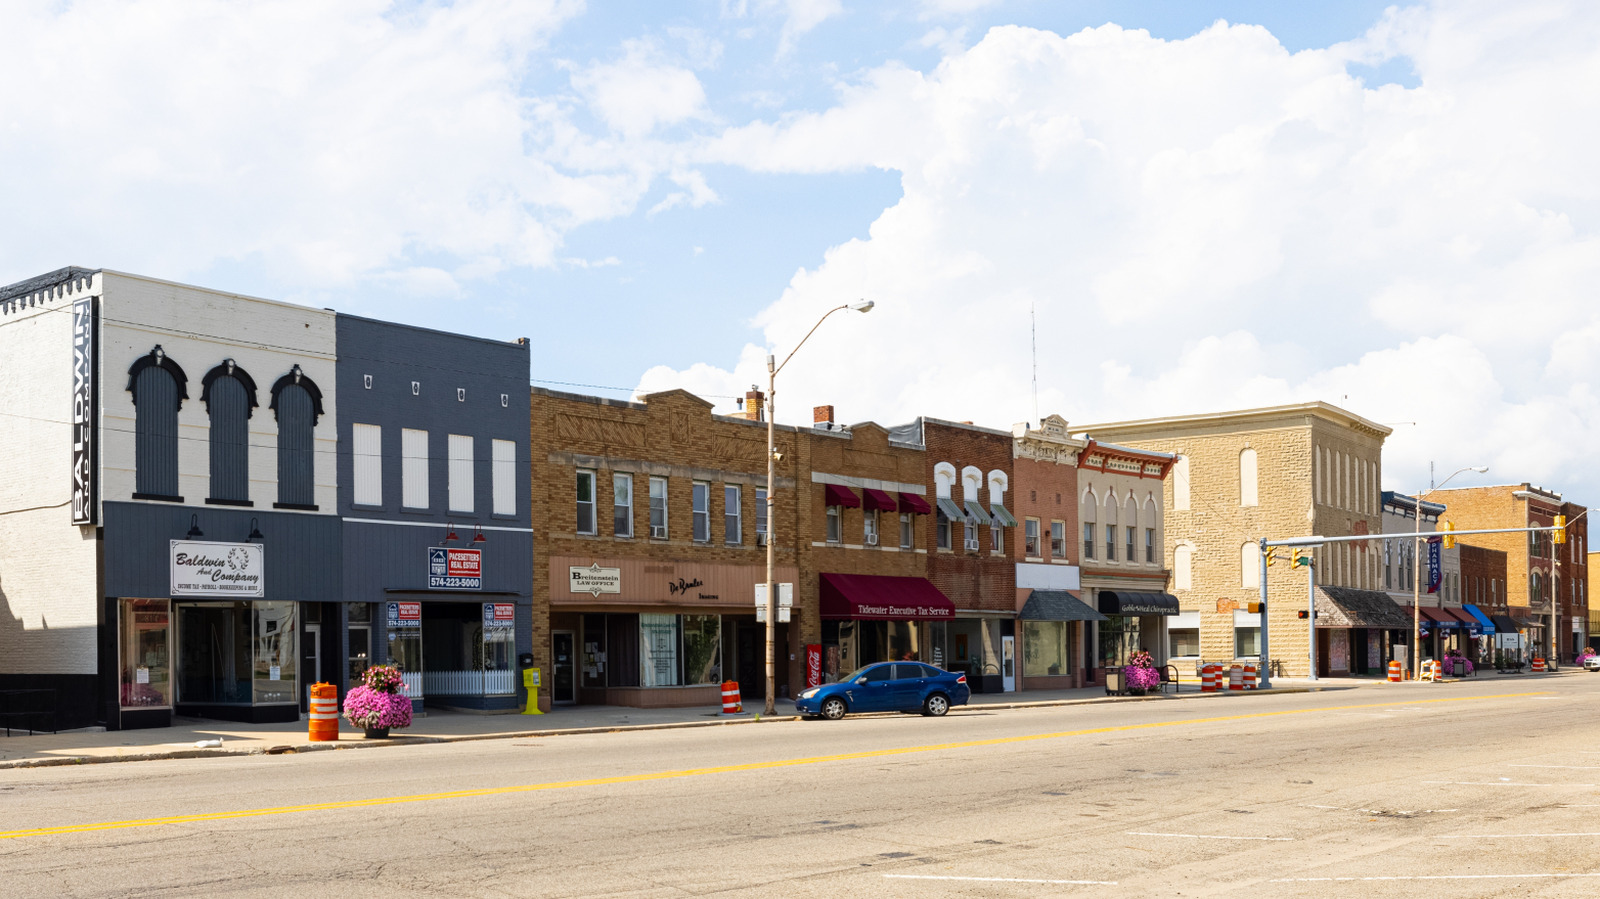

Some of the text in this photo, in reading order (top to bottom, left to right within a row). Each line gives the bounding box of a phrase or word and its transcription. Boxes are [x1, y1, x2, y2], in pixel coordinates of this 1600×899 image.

[74, 304, 84, 520] BALDWIN
[176, 553, 226, 568] Baldwin
[449, 553, 479, 561] PACESETTERS
[212, 569, 258, 584] Company
[572, 571, 619, 581] Breitenstein
[431, 578, 479, 587] 574-223-5000
[858, 605, 949, 616] Tidewater Executive Tax Service
[1150, 605, 1177, 614] Chiropractic
[808, 649, 820, 687] Coca-Cola
